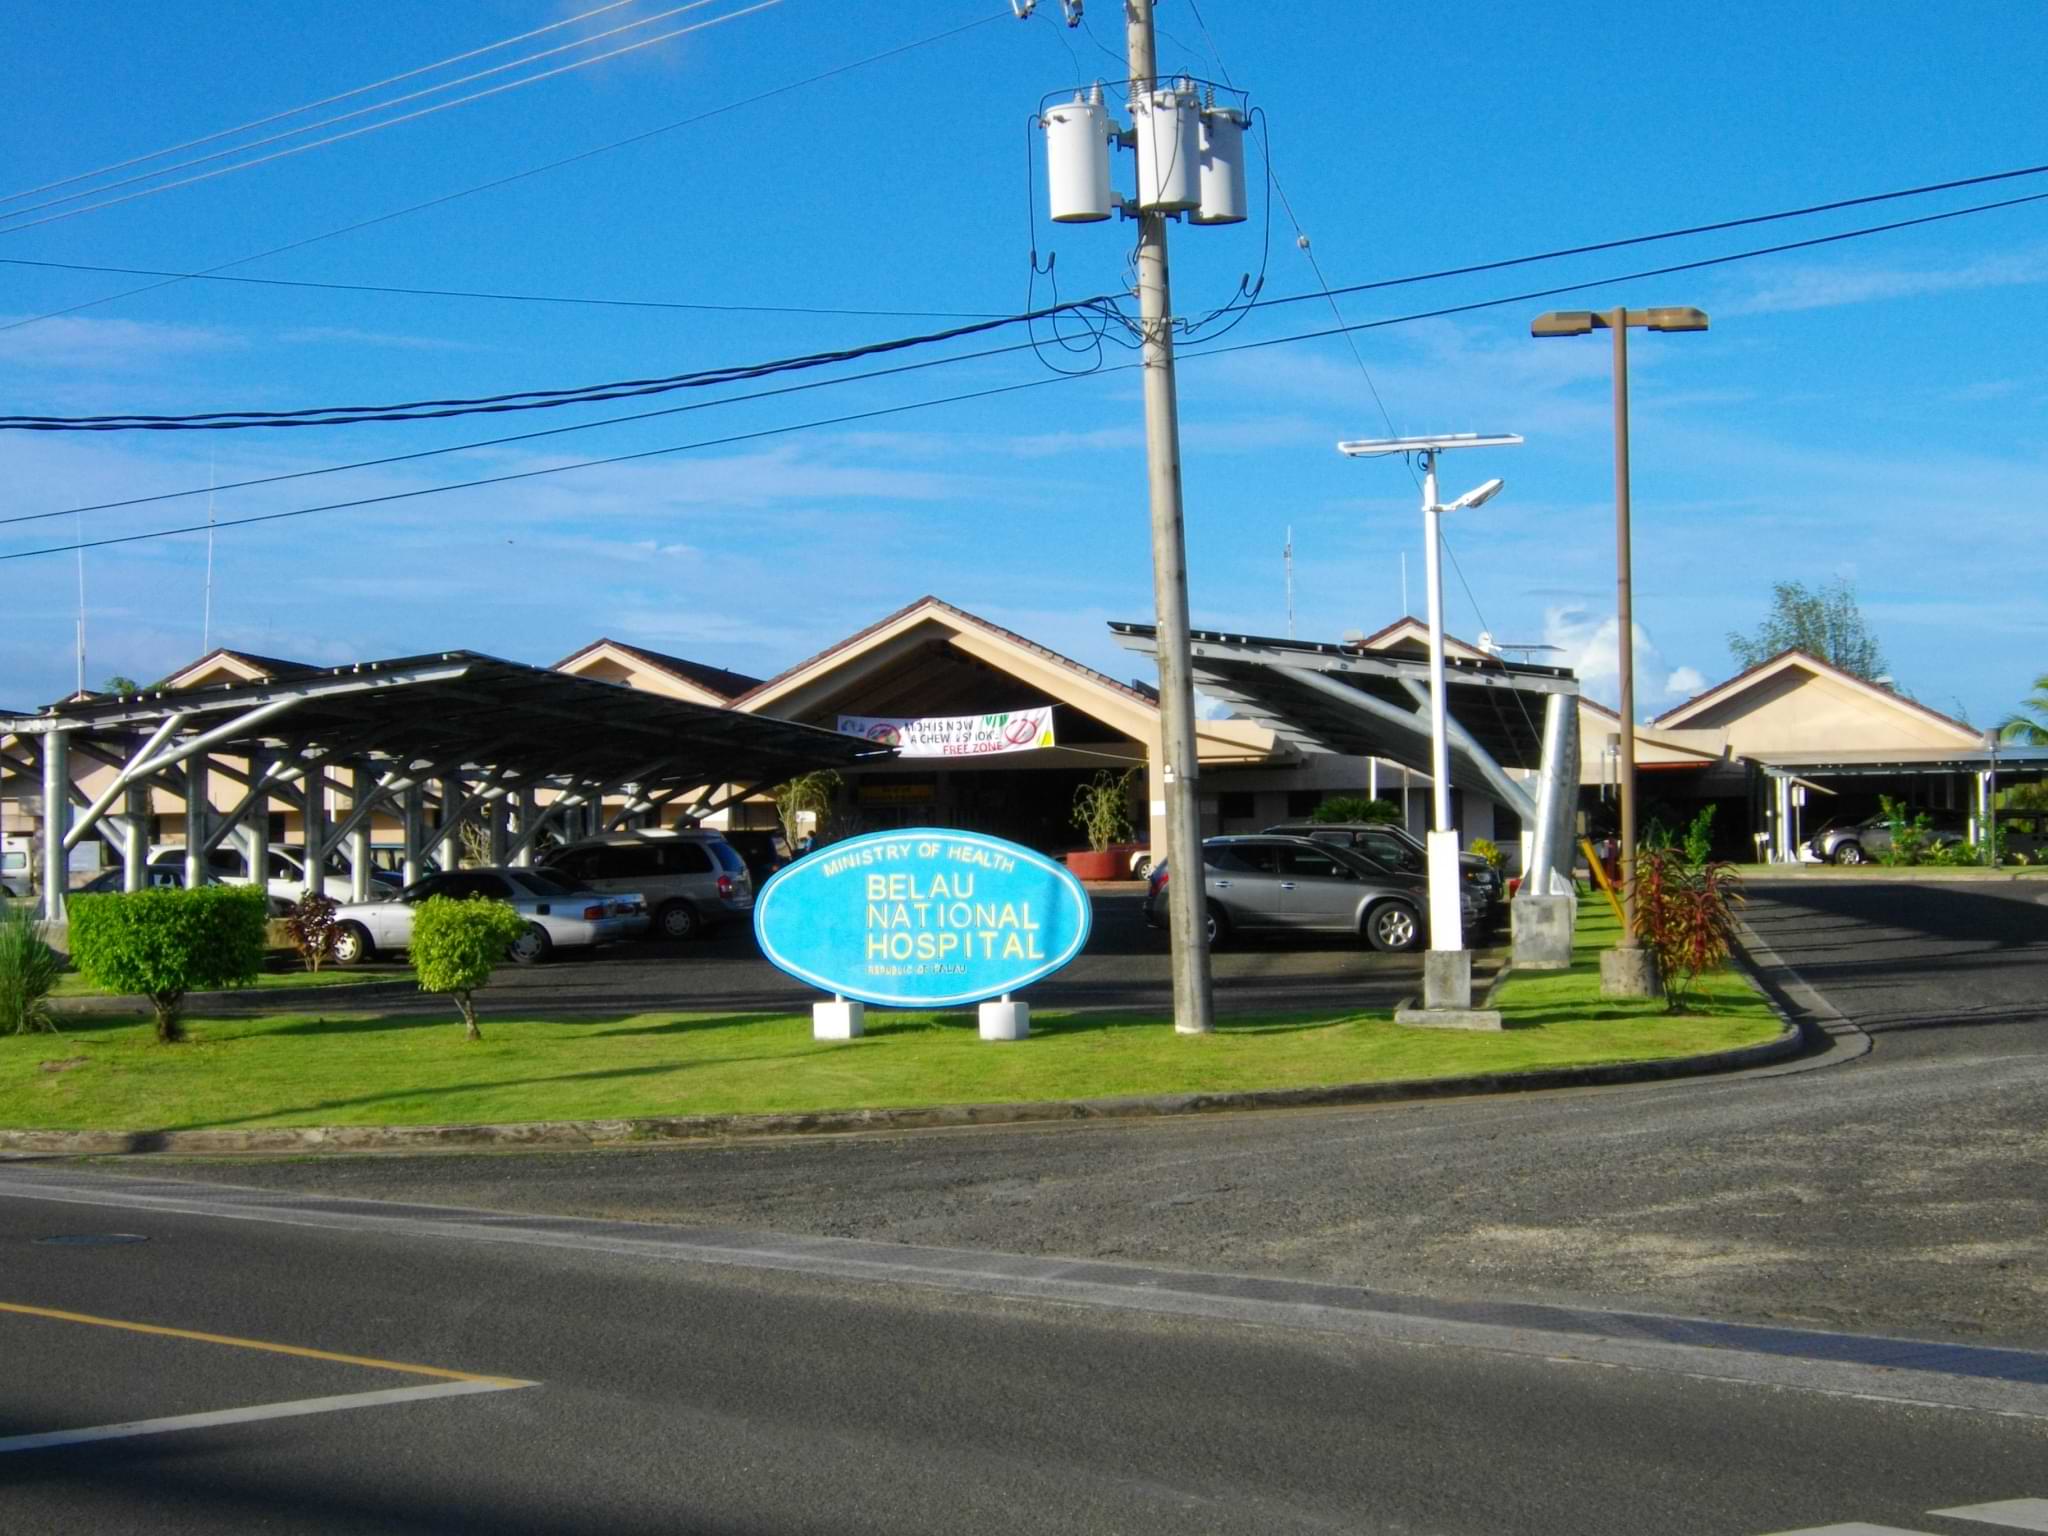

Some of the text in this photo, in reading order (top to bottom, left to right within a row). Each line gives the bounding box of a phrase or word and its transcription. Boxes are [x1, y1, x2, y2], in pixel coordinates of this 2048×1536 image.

[933, 720, 943, 732] IS
[946, 719, 974, 732] NOW
[910, 734, 918, 744] A
[920, 732, 951, 744] CHEW
[943, 741, 1004, 756] FREE ZONE
[823, 842, 1015, 877] MINISTRY OF HEALTH
[866, 872, 975, 900] BELAU
[866, 902, 1040, 930] NATIONAL
[866, 931, 1045, 960] HOSPITAL
[932, 962, 967, 974] PALAU
